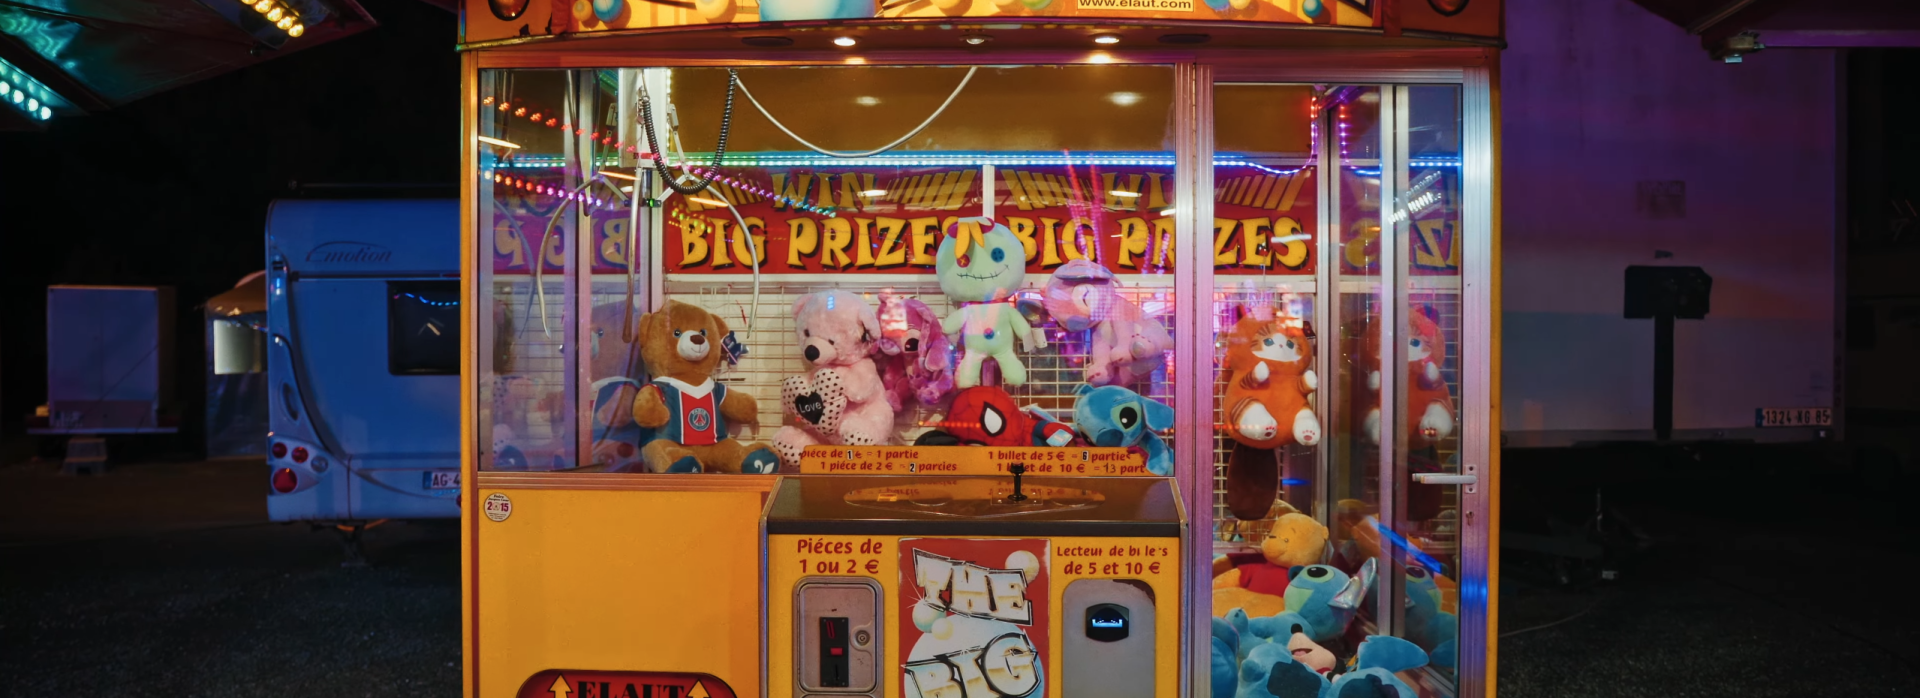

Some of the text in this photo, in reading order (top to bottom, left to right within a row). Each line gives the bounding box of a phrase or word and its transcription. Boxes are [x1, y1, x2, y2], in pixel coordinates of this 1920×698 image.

[1080, 0, 1191, 9] www.elaut.com
[771, 172, 876, 210] WIN
[1102, 171, 1175, 210] WI
[678, 215, 960, 268] BIG PRIZE
[1005, 216, 1310, 269] BIG PRZES
[799, 402, 822, 413] Love
[1765, 410, 1792, 424] 1324
[1815, 409, 1830, 424] 85
[831, 449, 843, 458] de
[847, 450, 853, 459] 1
[877, 450, 882, 458] 1
[885, 449, 919, 461] partie
[988, 451, 993, 460] 1
[998, 451, 1026, 460] billet
[1030, 451, 1043, 460] de
[1047, 452, 1053, 460] 5
[1056, 452, 1065, 461] €
[820, 461, 825, 470] 1
[830, 461, 856, 472] piéce
[860, 461, 873, 470] de
[876, 462, 882, 470] 2
[885, 462, 893, 471] €
[909, 463, 915, 472] 2
[996, 463, 1001, 472] 1
[1039, 463, 1052, 472] de
[1060, 464, 1072, 473] 10
[1076, 464, 1085, 473] €
[797, 538, 883, 554] Piéces de
[1109, 545, 1124, 556] de
[799, 559, 879, 574] 1 ou 2 €
[1064, 561, 1160, 575] de 5 et 10 €
[912, 547, 1033, 626] THE
[901, 630, 1042, 698] BIG
[577, 681, 684, 698] ELAUT
